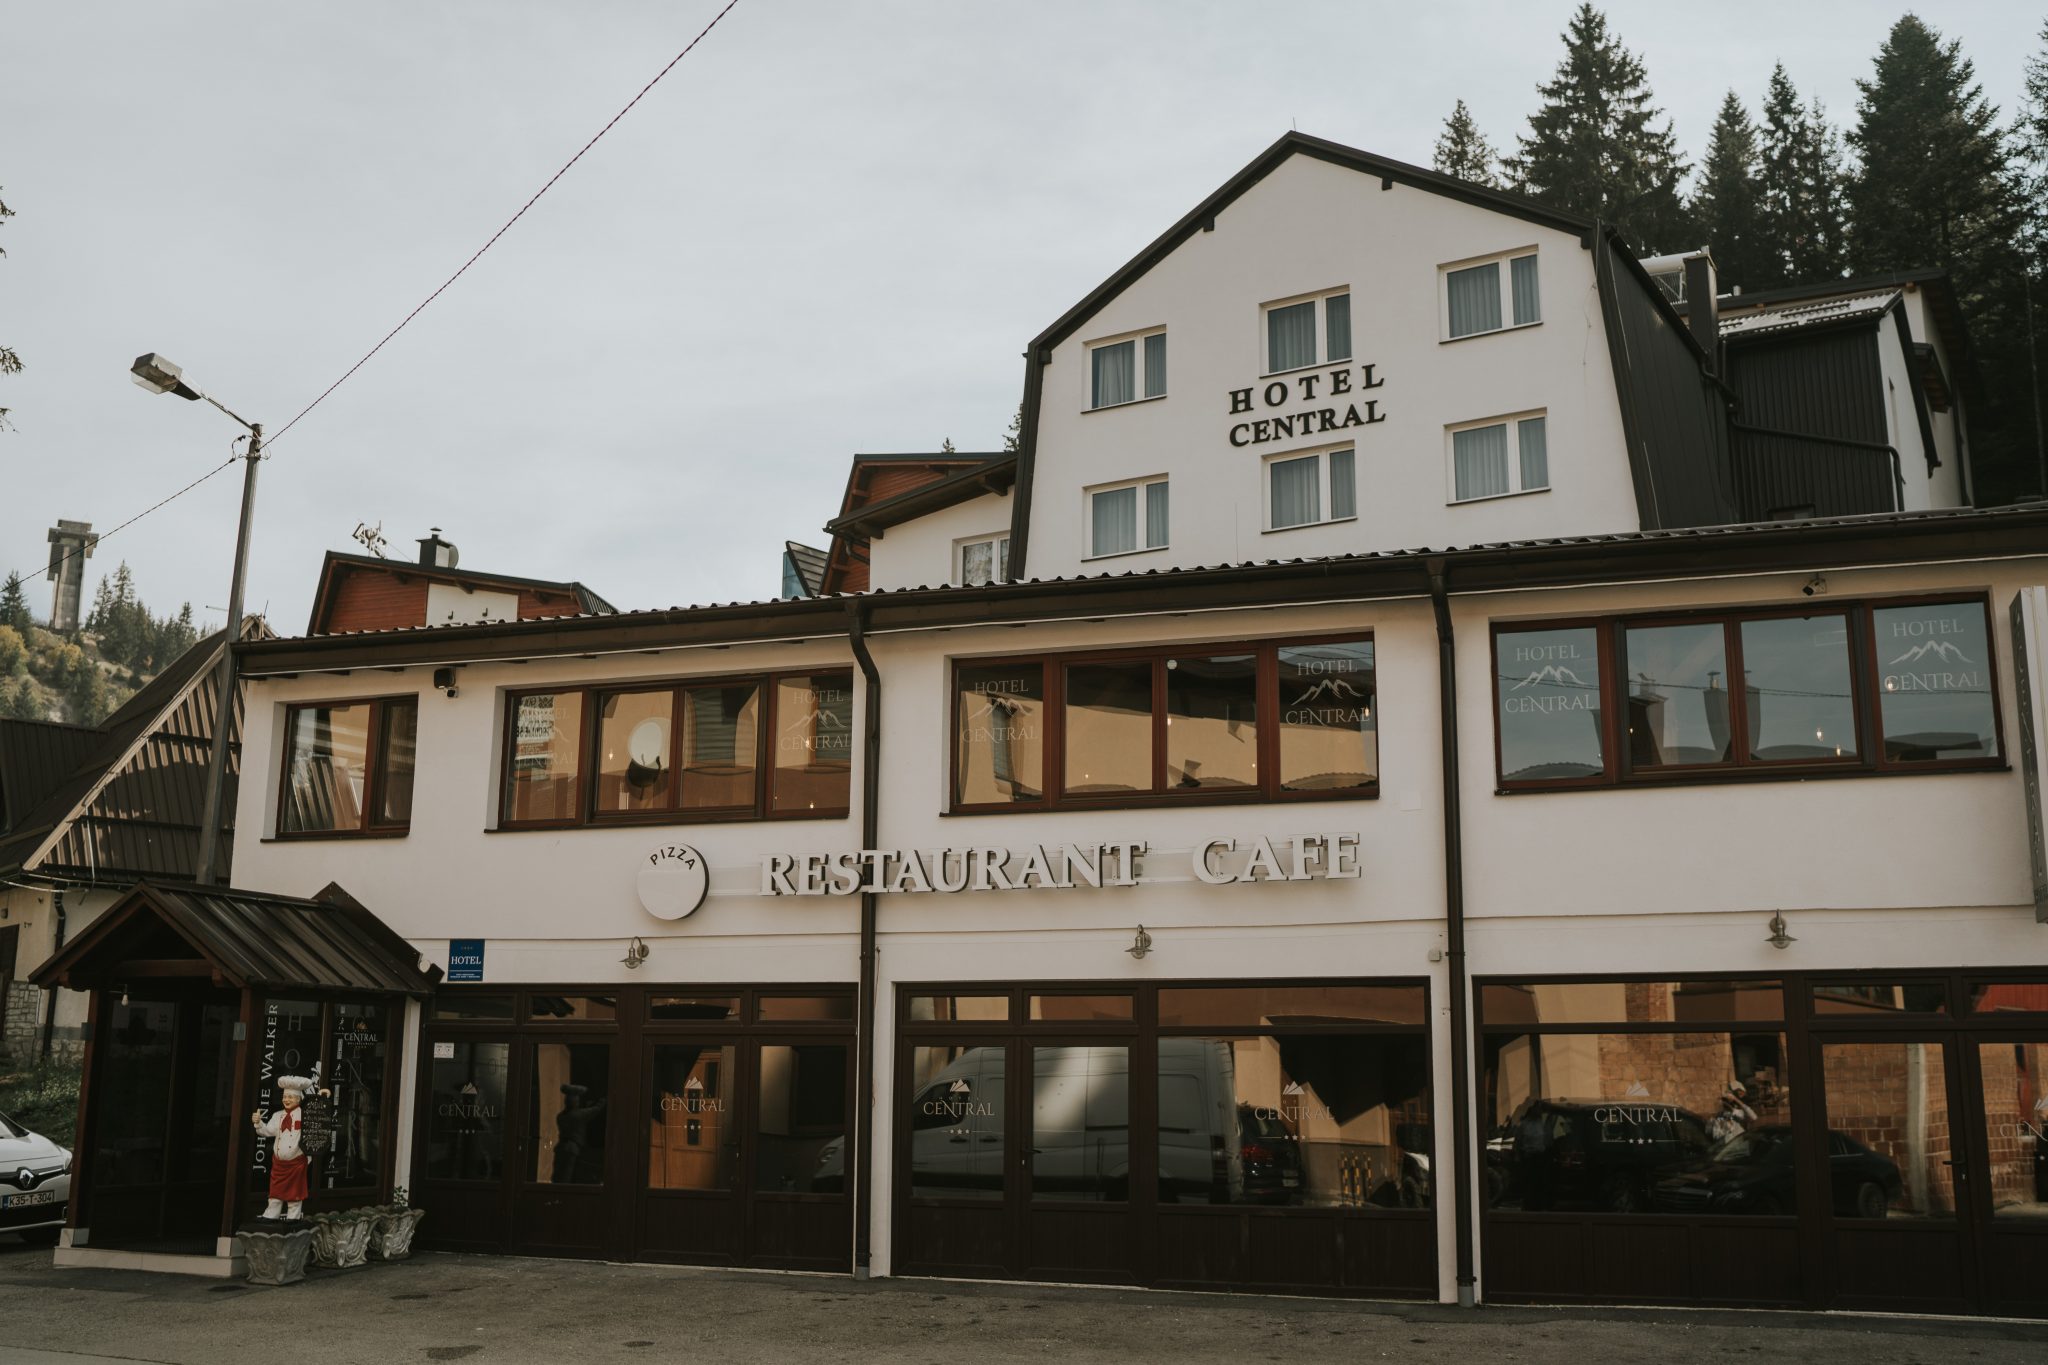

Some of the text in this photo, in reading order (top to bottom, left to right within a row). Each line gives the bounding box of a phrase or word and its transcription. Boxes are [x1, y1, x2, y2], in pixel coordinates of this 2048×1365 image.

[1228, 363, 1385, 415] HOTEL
[1229, 399, 1387, 448] CENTRAL
[1893, 618, 1965, 638] HOTEL
[1516, 645, 1581, 661] HOTEL
[1297, 659, 1359, 676] HOTEL
[975, 679, 1030, 696] HOTEL
[1884, 671, 1985, 692] CENTRAL
[793, 689, 844, 705] HOTEL
[1505, 694, 1595, 715] CENTRAL
[1285, 706, 1371, 726] CENTRAL
[781, 734, 852, 752] CENTRAL
[962, 726, 1040, 744] CENTRAL
[649, 846, 697, 871] PIZZA
[759, 832, 1362, 897] RESTAURANT CAFE
[450, 955, 482, 965] HOTEL
[344, 1031, 378, 1043] CENTRAL
[252, 1003, 279, 1173] JOHNIE WALKER
[438, 1102, 497, 1119] CENTRAL
[660, 1096, 726, 1113] CENTRAL
[923, 1099, 995, 1118] CENTRAL
[1254, 1106, 1335, 1123] CENTRAL
[1594, 1106, 1683, 1126] CENTRAL
[9, 1192, 52, 1206] K35-T-304
